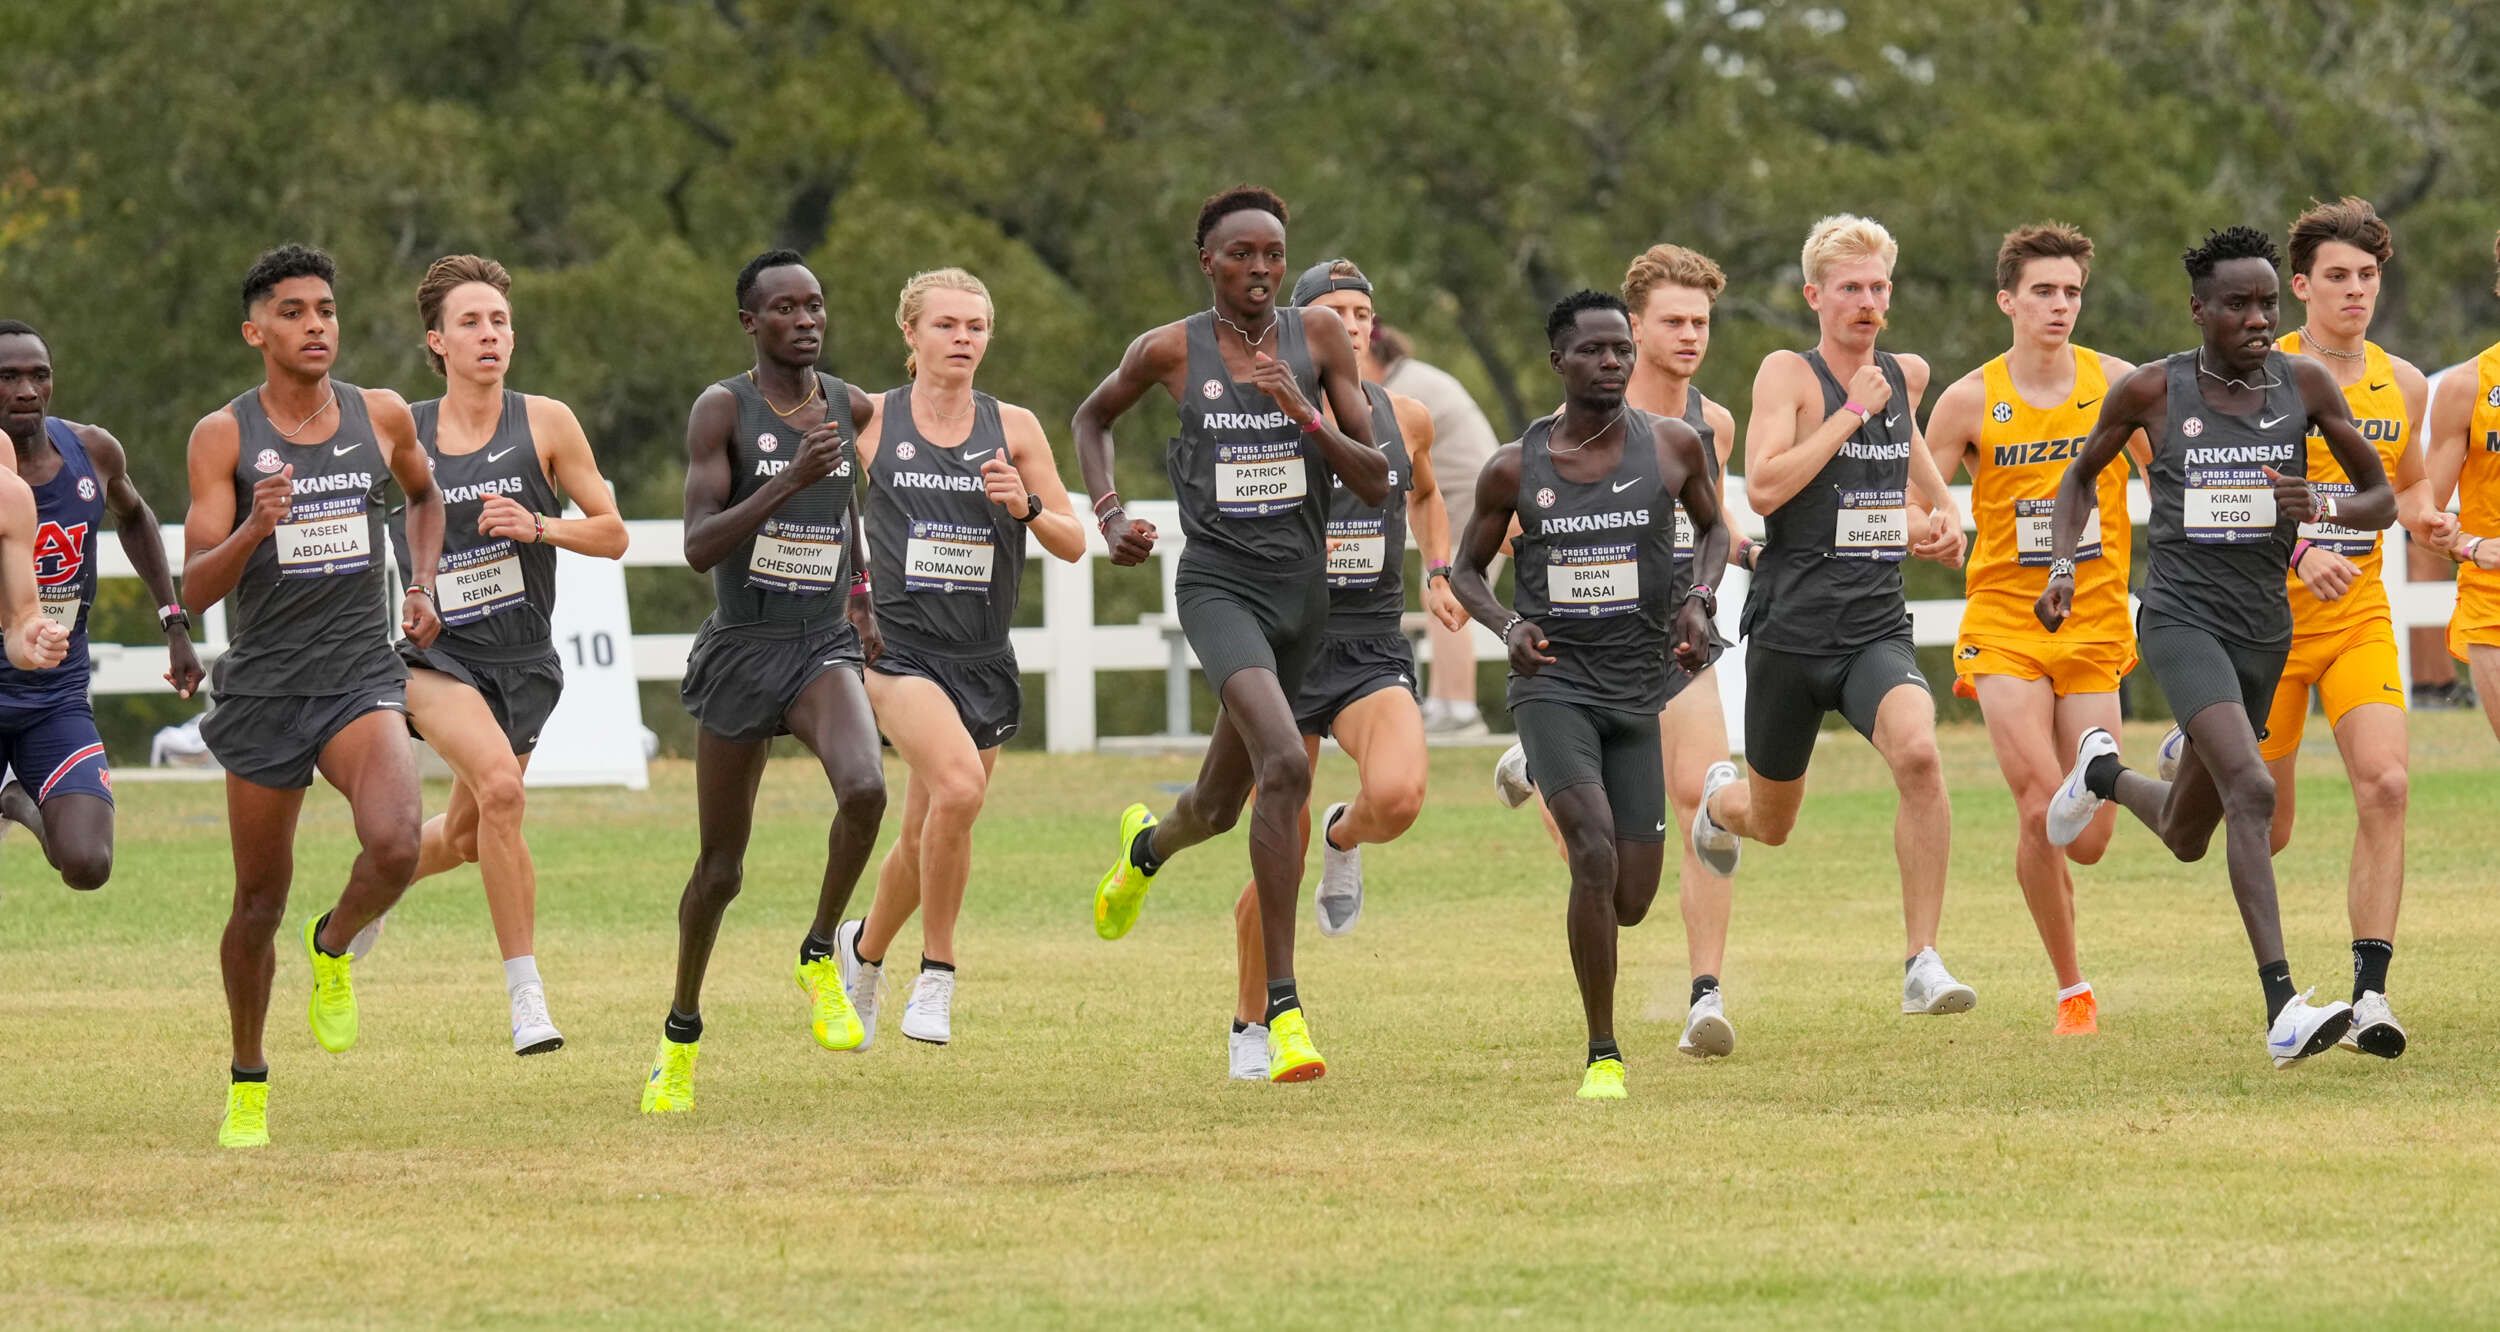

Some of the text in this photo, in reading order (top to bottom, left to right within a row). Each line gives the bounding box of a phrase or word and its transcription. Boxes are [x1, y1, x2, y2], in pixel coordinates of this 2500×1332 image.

[1203, 380, 1223, 399] SEC
[1203, 411, 1297, 430] ARKANSA
[2183, 417, 2203, 437] SEC
[1231, 441, 1298, 454] CROSS COUNTRY
[1994, 436, 2090, 466] MIZZO
[2184, 443, 2295, 465] ARKANSAS
[1236, 449, 1295, 461] CHAMPIONSHIPS
[1236, 466, 1286, 478] PATRICK
[291, 472, 372, 495] KANSAS
[893, 472, 986, 491] ARKANSA
[443, 476, 523, 504] KANSAS
[1236, 482, 1288, 497] KIPROP
[1537, 489, 1556, 507] SEC
[2211, 494, 2252, 503] KIRAMI
[292, 498, 361, 514] CROSS COUNTRY
[297, 507, 358, 521] CHAMPIONSHIPS
[1867, 514, 1887, 523] BEN
[2211, 511, 2251, 522] YEGO
[779, 522, 841, 535] CROSS COUNTRY
[927, 523, 991, 535] CROSS COUNTRY
[1347, 521, 1381, 529] COUNTRY
[1541, 509, 1649, 535] ARKANSAS
[301, 524, 348, 538] YASEEN
[782, 531, 834, 541] CHAMPIONSHIPS
[931, 532, 987, 542] CHAMPIONSHIPS
[1327, 528, 1378, 536] HAMPIONSHIPS
[1848, 530, 1901, 542] SHEARER
[292, 540, 359, 558] ABDALLA
[447, 541, 511, 562] CROSS COUNTRY
[777, 544, 823, 557] TIMOTHY
[933, 546, 973, 558] TOMMY
[1592, 546, 1631, 555] COUNTRY
[453, 549, 509, 569] CHAMPIONSHIPS
[1329, 558, 1374, 568] HREML
[1567, 554, 1627, 564] CHAMPIONSHIPS
[757, 557, 833, 577] CHESONDIN
[914, 560, 985, 576] ROMANOW
[457, 567, 501, 585] REUBEN
[1574, 570, 1610, 580] BRIAN
[462, 584, 502, 602] REINA
[1571, 586, 1615, 598] MASAI
[569, 633, 614, 667] 10
